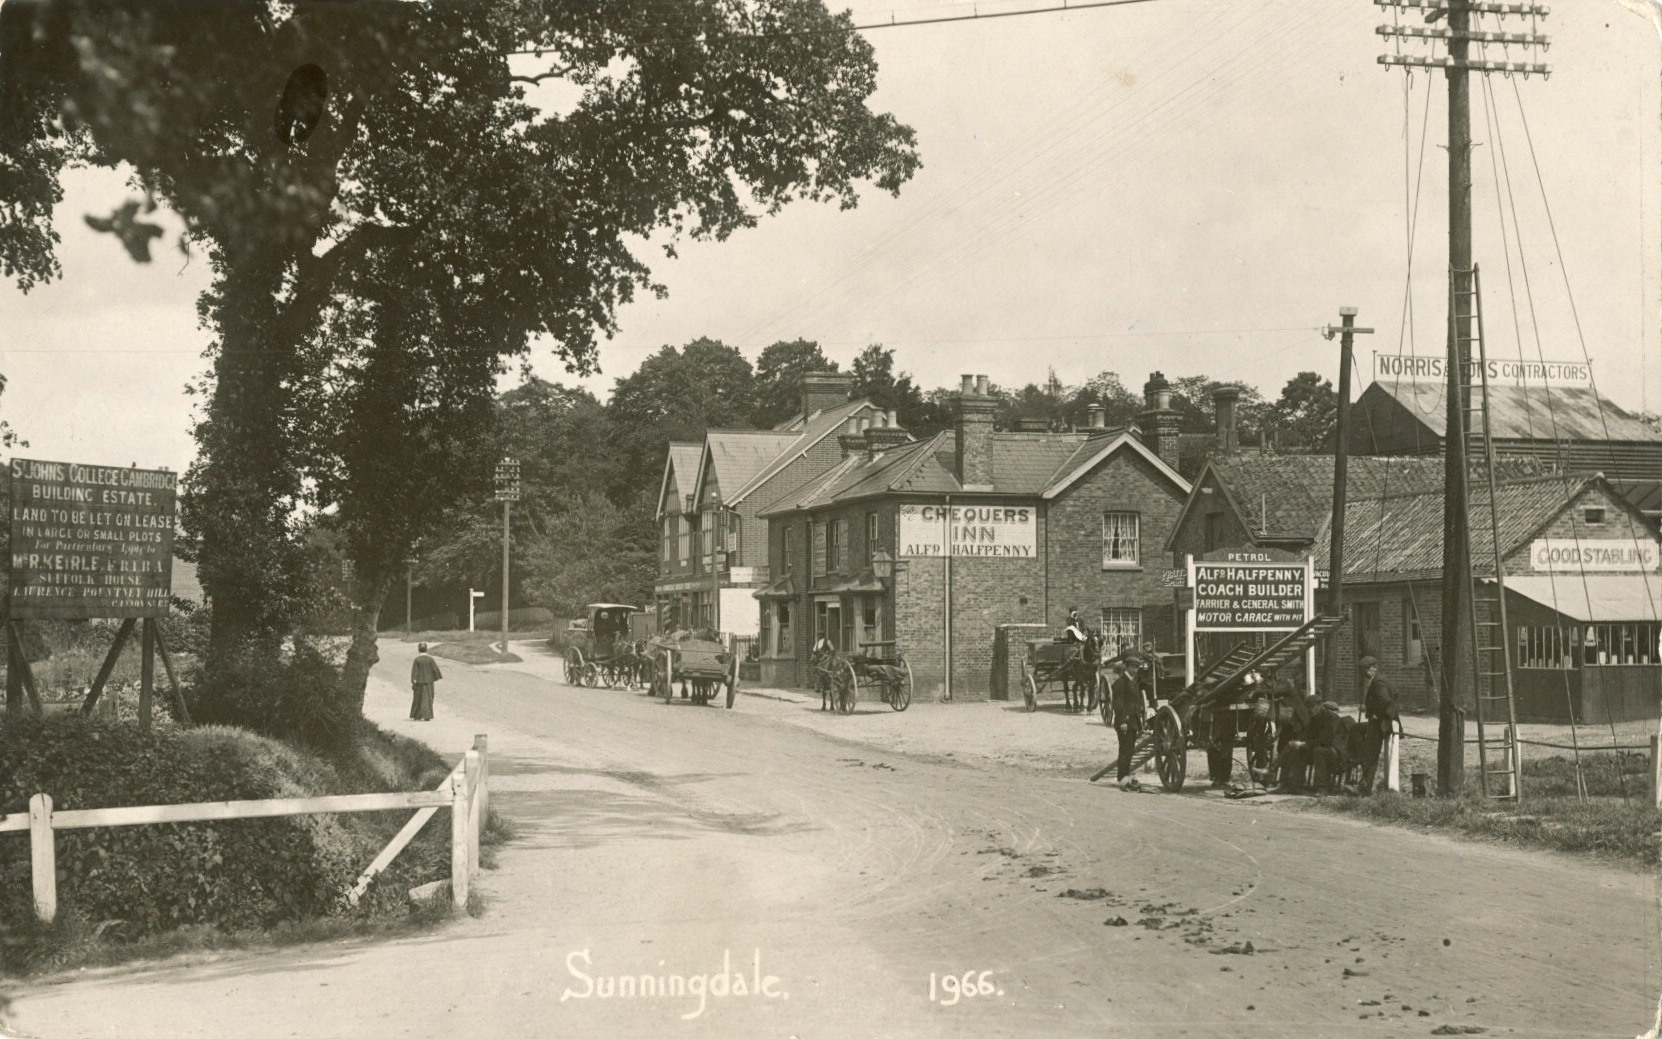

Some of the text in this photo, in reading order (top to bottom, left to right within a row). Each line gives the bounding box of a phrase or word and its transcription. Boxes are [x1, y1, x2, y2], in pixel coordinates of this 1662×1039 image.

[1380, 356, 1442, 377] NORRIS
[1502, 361, 1588, 380] CONTRACTORS
[69, 463, 119, 487] COLLEGE
[120, 469, 177, 490] CAMBRIDGE
[32, 484, 93, 502] BUILDING
[13, 507, 172, 529] LAND TO BE LET ON LEASE
[921, 505, 1030, 523] CHEQUERS
[22, 526, 162, 542] IN LARGE OR SMALL PLOTS
[952, 525, 996, 543] INN
[952, 544, 1032, 557] HALFPENNY
[1228, 553, 1272, 562] PETROL
[1537, 547, 1653, 565] GOOD STABLING
[104, 574, 142, 586] HOUSE
[1198, 584, 1303, 596] COACH BUILDER
[1196, 599, 1305, 610] FARRIER & GENERAL SMITH
[1197, 612, 1303, 622] MOTOR GARAGE WITH PIT
